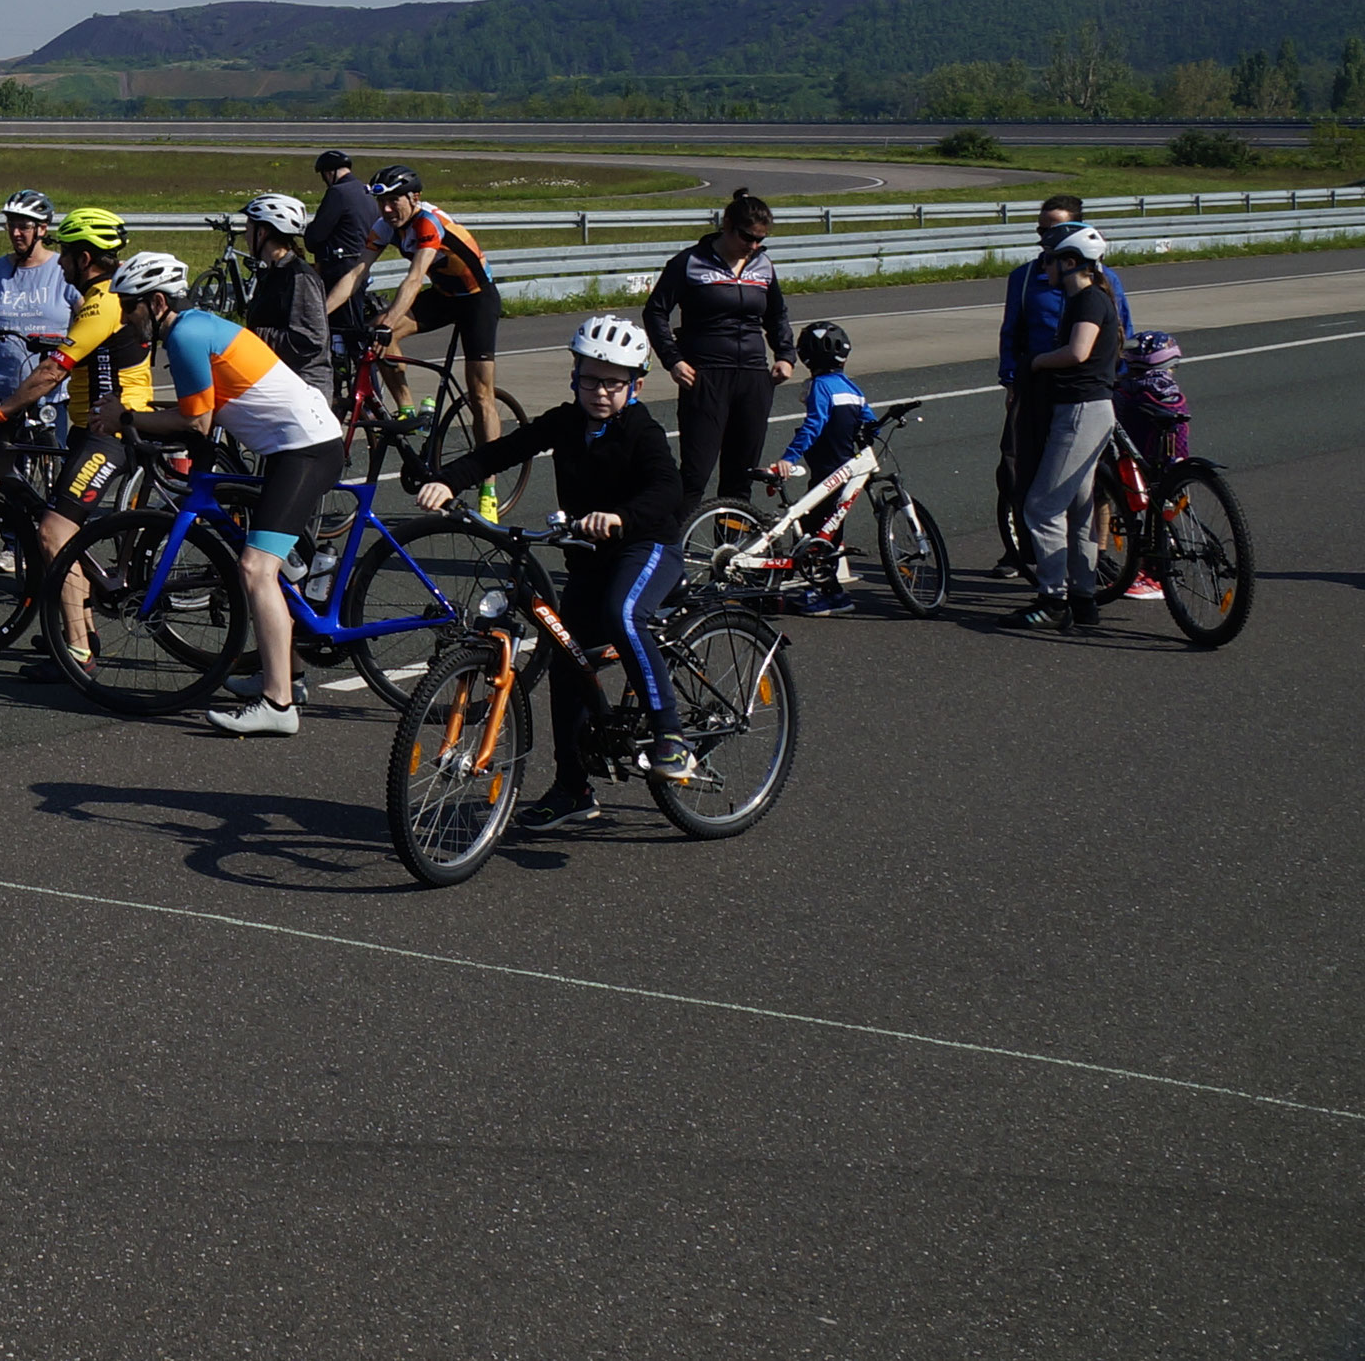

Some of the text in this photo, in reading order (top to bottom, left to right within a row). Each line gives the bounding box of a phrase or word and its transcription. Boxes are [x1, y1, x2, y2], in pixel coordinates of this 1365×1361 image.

[69, 452, 107, 499] JUMBO
[90, 461, 117, 489] VISMA
[535, 605, 589, 666] PEGASUS
